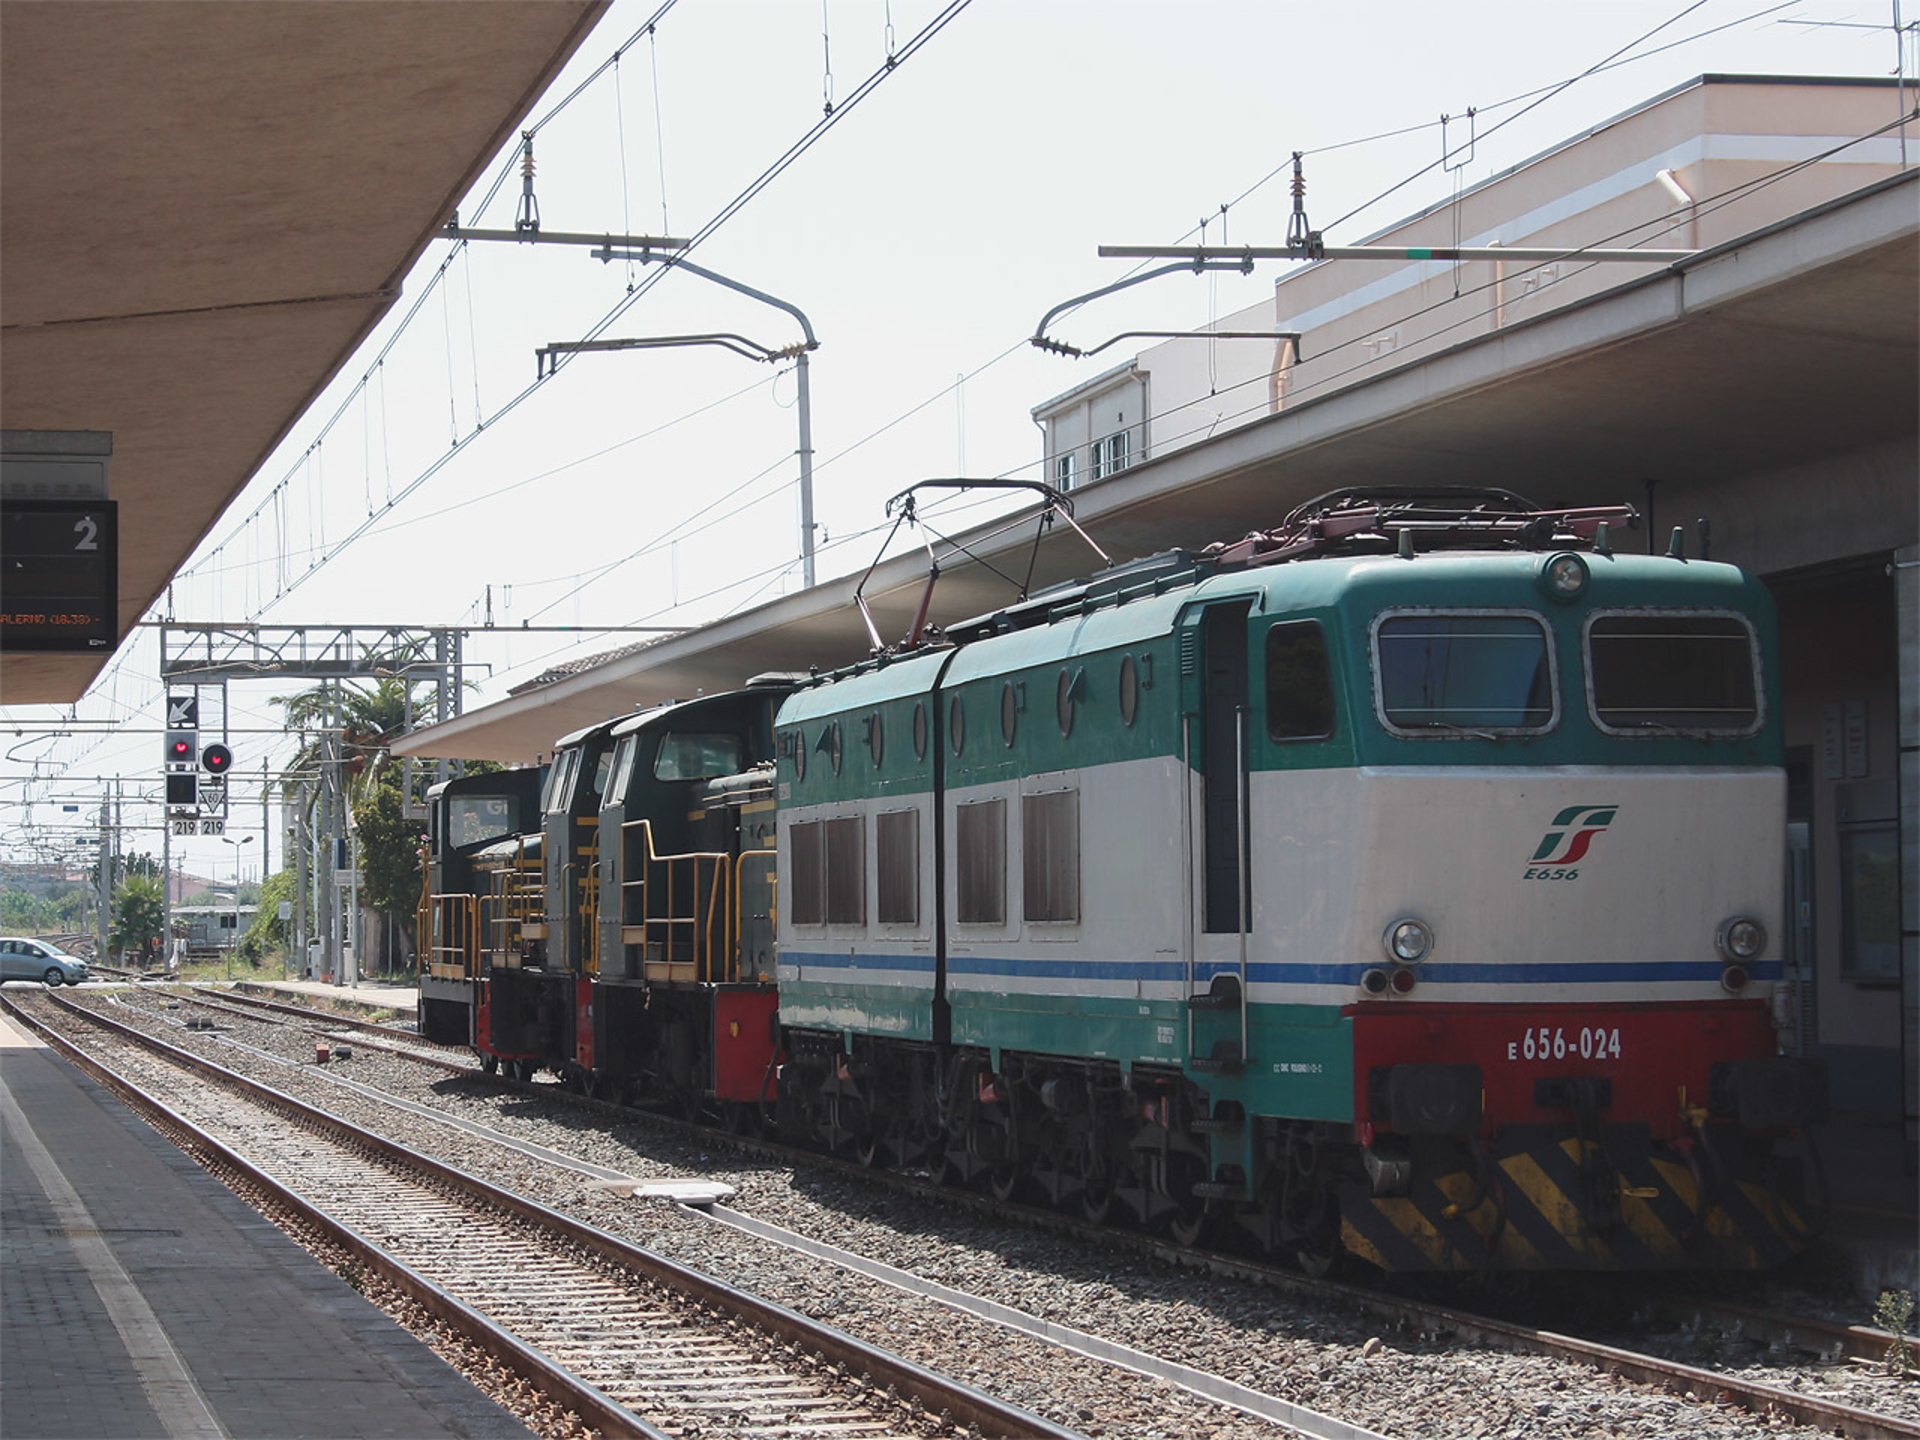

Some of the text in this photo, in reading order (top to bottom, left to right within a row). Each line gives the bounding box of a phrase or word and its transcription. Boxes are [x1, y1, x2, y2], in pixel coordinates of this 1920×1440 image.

[73, 518, 98, 550] 2
[0, 614, 46, 624] ALERNO
[208, 792, 218, 804] 60
[175, 821, 196, 834] 219
[203, 820, 223, 833] 219
[1523, 868, 1579, 880] E656
